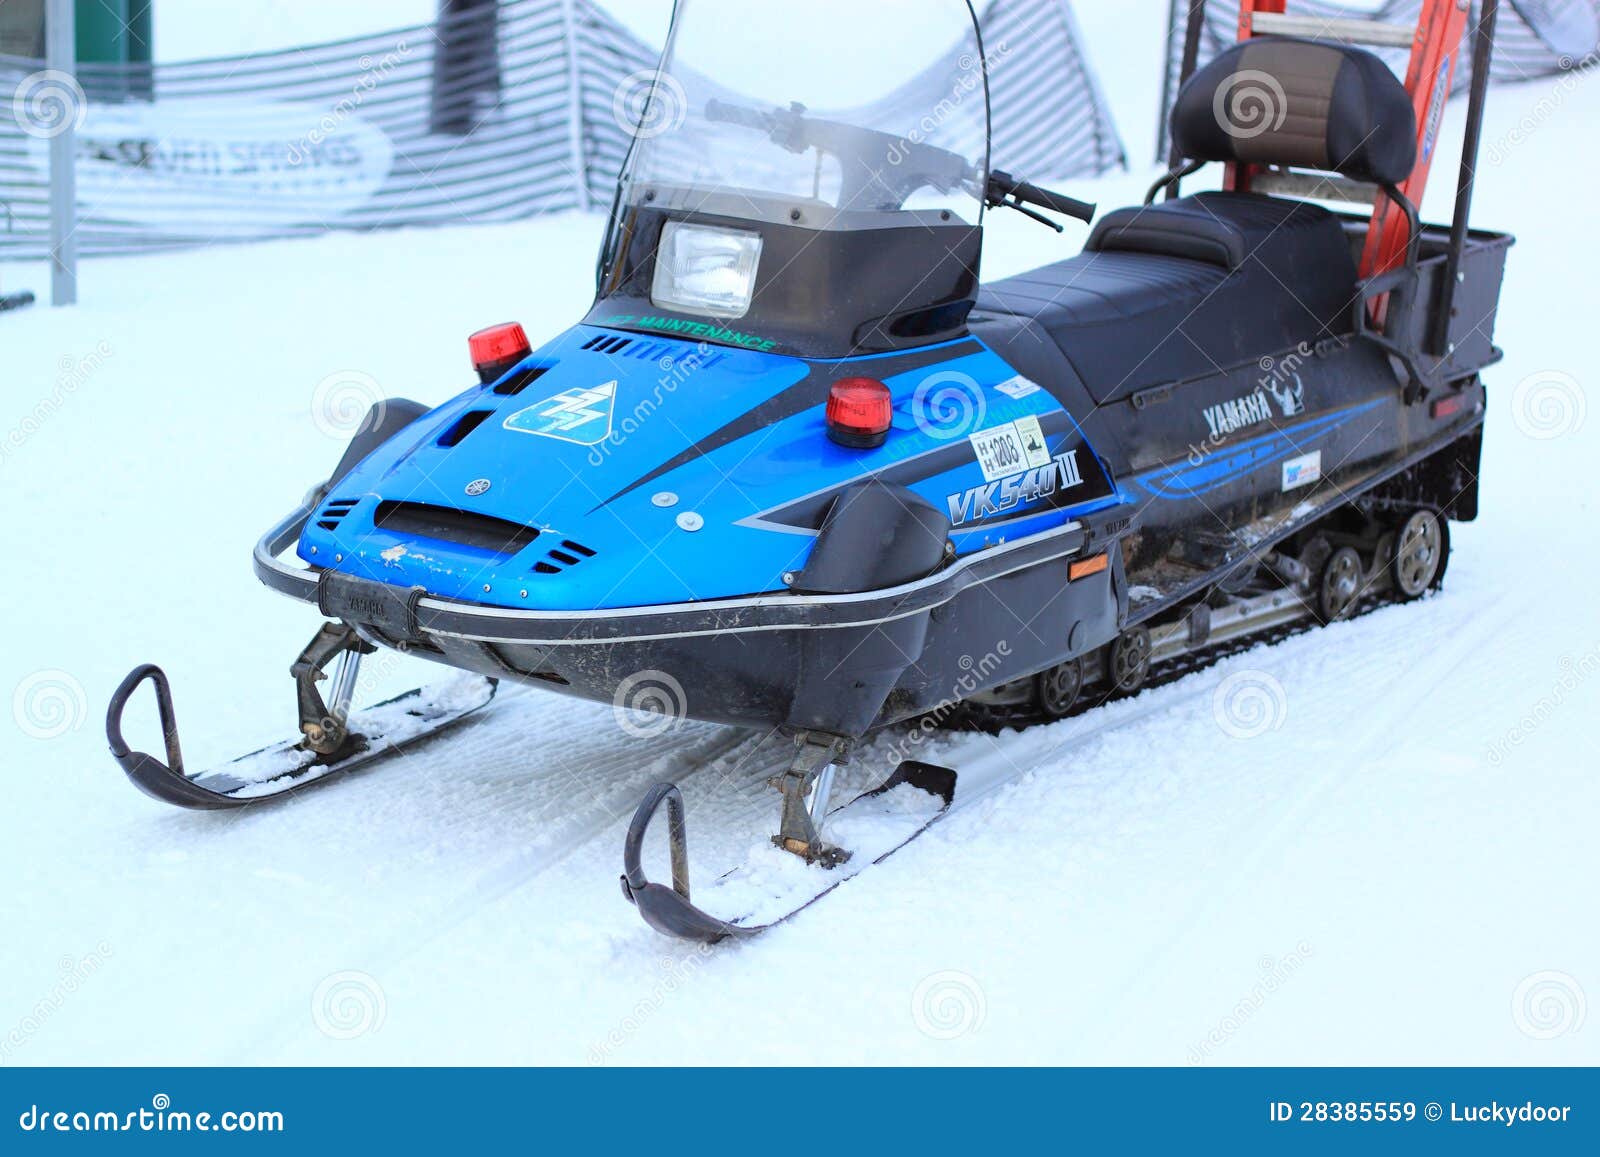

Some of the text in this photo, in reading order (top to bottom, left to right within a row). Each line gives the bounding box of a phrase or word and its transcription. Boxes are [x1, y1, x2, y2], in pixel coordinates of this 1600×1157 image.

[637, 316, 777, 351] MAINTENANCE
[1203, 391, 1273, 437] YAMAHA
[990, 434, 1019, 467] 1208
